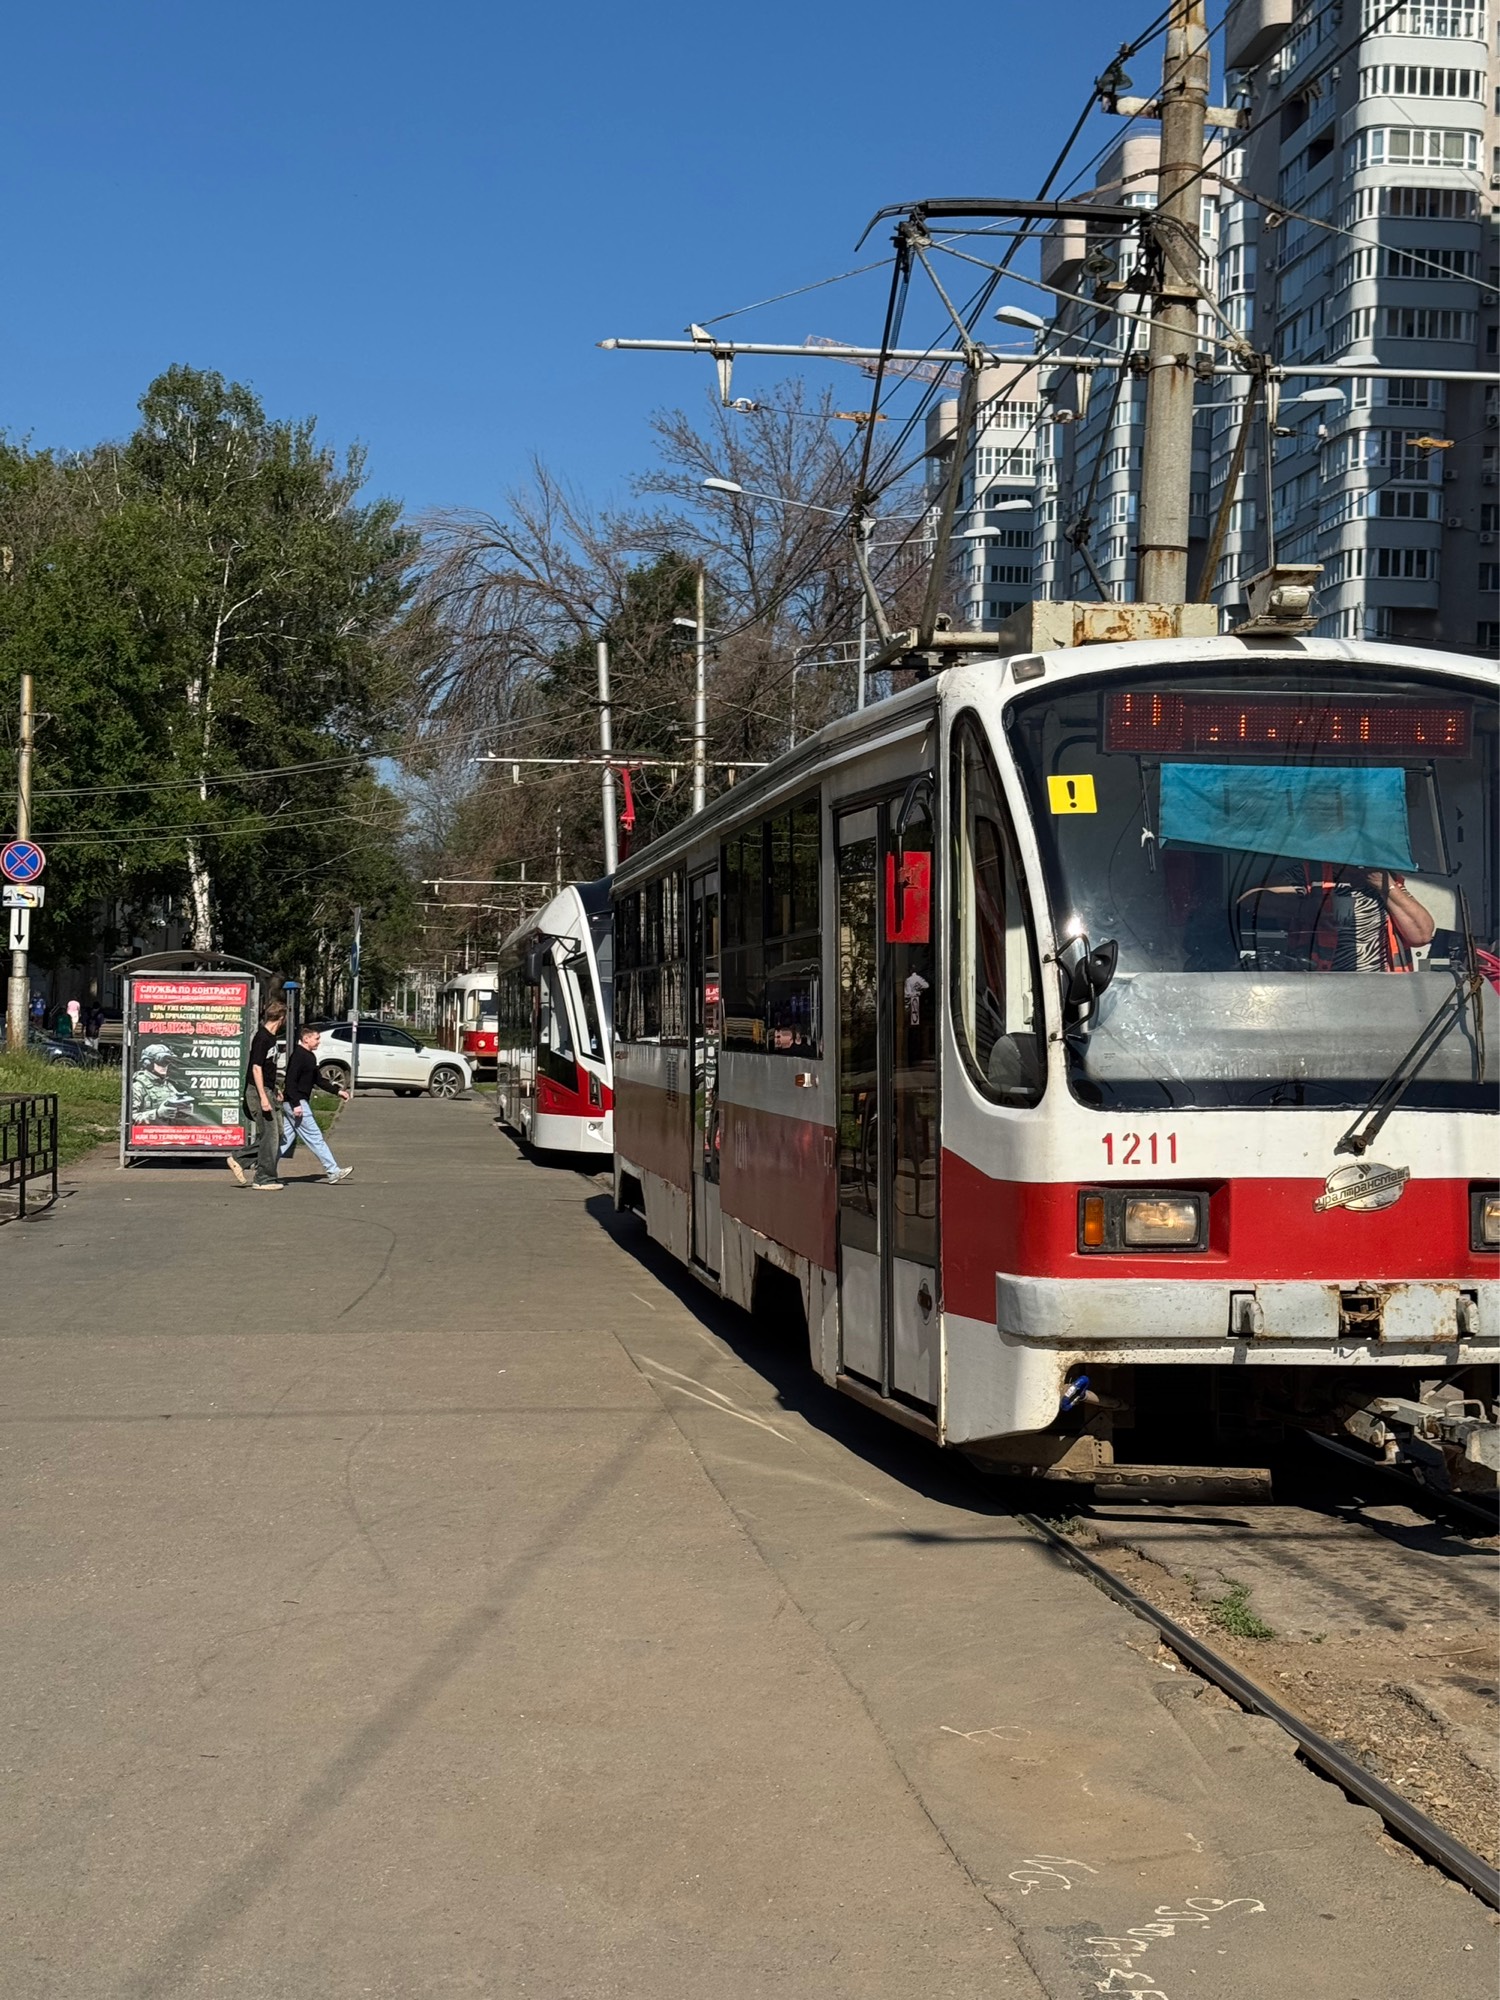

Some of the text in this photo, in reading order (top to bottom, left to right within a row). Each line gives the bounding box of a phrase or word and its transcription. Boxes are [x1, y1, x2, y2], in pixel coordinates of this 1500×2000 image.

[140, 985, 242, 995] СЛУЖБА ПО КОНТРАКТУ
[191, 1046, 198, 1058] 4
[199, 1046, 219, 1058] 700
[221, 1046, 241, 1058] 000
[218, 1059, 240, 1067] РУБЛЕЙ
[190, 1077, 240, 1089] 2 200 000
[1102, 1132, 1177, 1165] 1211
